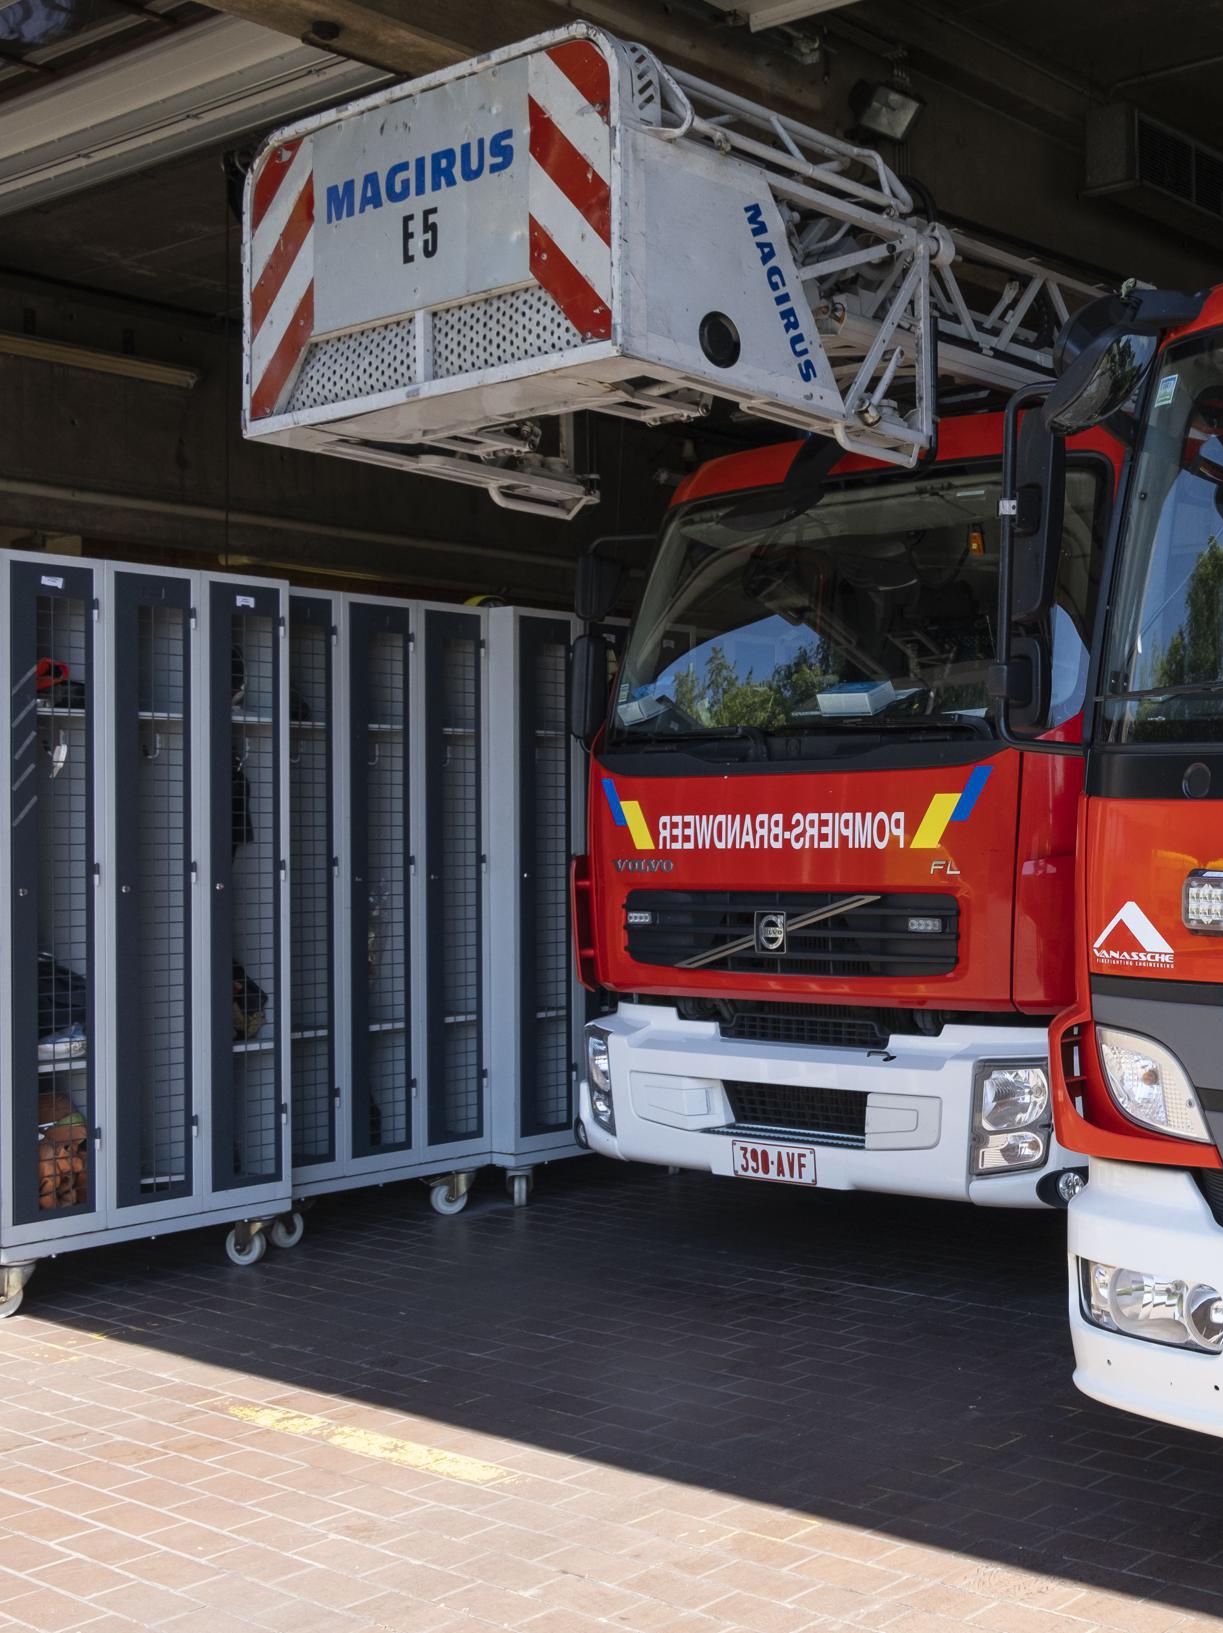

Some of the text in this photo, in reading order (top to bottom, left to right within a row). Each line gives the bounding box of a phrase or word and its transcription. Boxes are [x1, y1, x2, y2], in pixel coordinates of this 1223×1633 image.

[326, 128, 514, 225] MAGIRUS
[743, 203, 818, 383] MAGIRUS
[612, 859, 674, 873] VOLVO
[930, 860, 961, 875] FL
[1093, 948, 1174, 963] VANASSCHE
